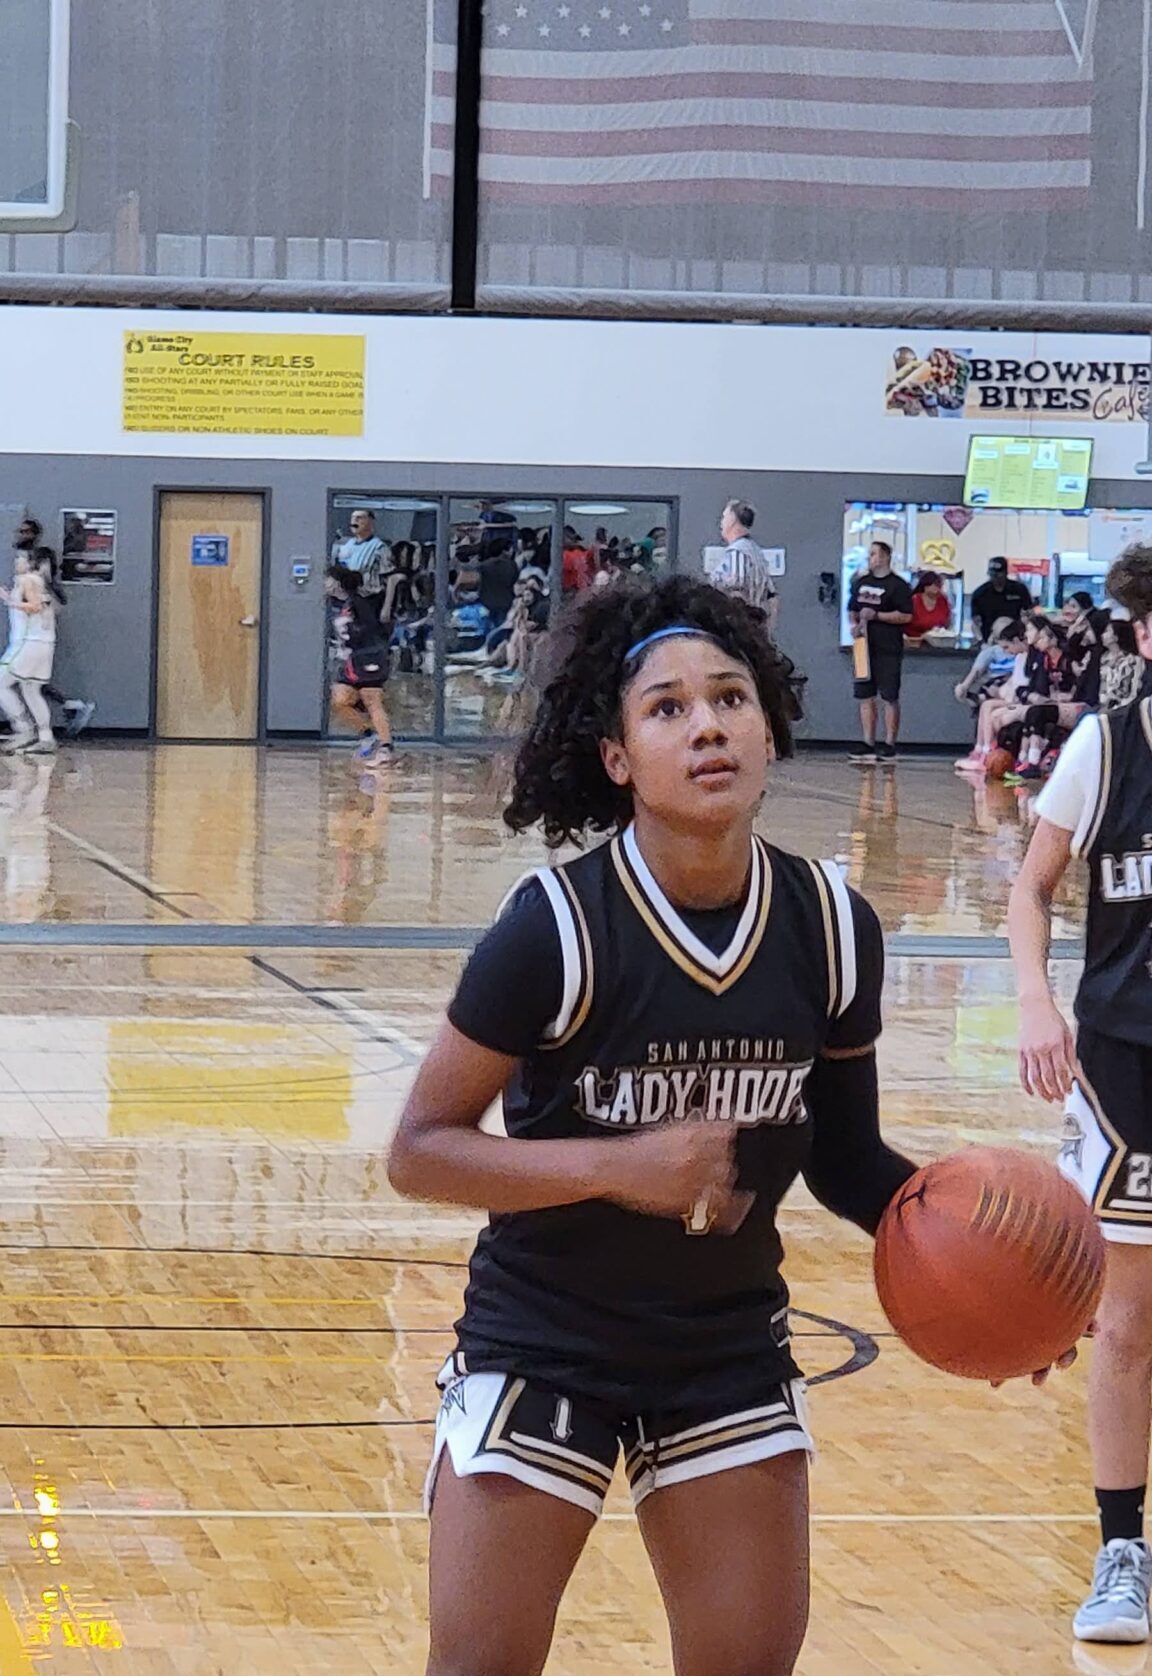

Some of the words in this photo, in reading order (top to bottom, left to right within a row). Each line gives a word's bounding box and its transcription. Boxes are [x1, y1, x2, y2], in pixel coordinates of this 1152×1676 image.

[175, 336, 194, 345] City
[178, 353, 245, 368] COURT
[251, 355, 315, 368] RULES
[142, 377, 186, 385] SHOOTING
[219, 378, 262, 386] PARTIALLY
[251, 369, 286, 377] PAYMENT
[969, 359, 1150, 385] BROWNIE
[262, 389, 287, 397] COURT
[979, 386, 1091, 410] BITES
[648, 1041, 688, 1062] SAN
[697, 1038, 784, 1061] ANTONIO
[582, 1070, 698, 1124] LADY
[1126, 1152, 1152, 1197] 2
